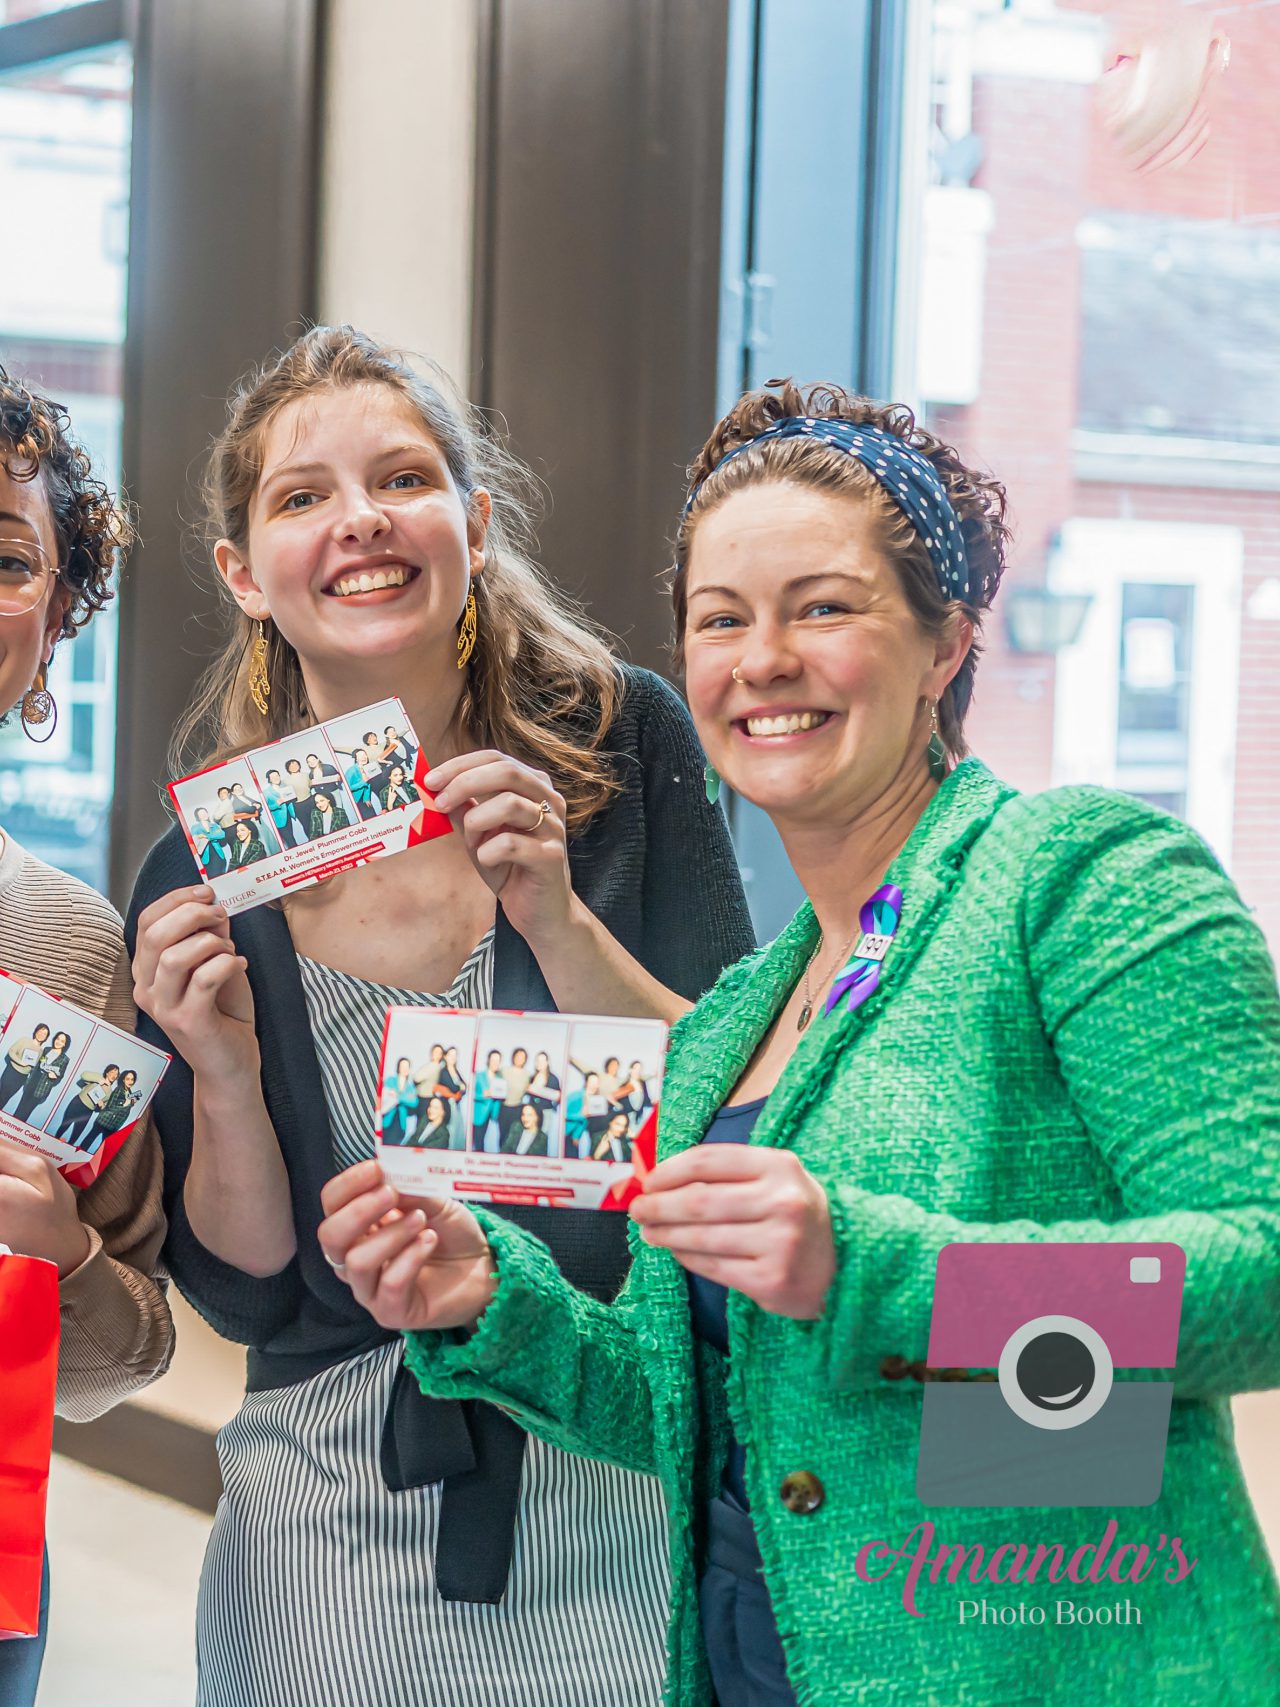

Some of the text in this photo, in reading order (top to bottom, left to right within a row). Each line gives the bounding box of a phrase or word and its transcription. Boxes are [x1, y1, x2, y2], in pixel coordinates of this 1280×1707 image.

[256, 824, 403, 882] S.T.E.A.M. Women's Empowerment Initiatives
[284, 826, 367, 861] Dr. Jewel Plummer Cobb
[220, 889, 256, 908] RUTGERS
[24, 1129, 41, 1141] Cobb
[35, 1145, 63, 1162] Initiatives
